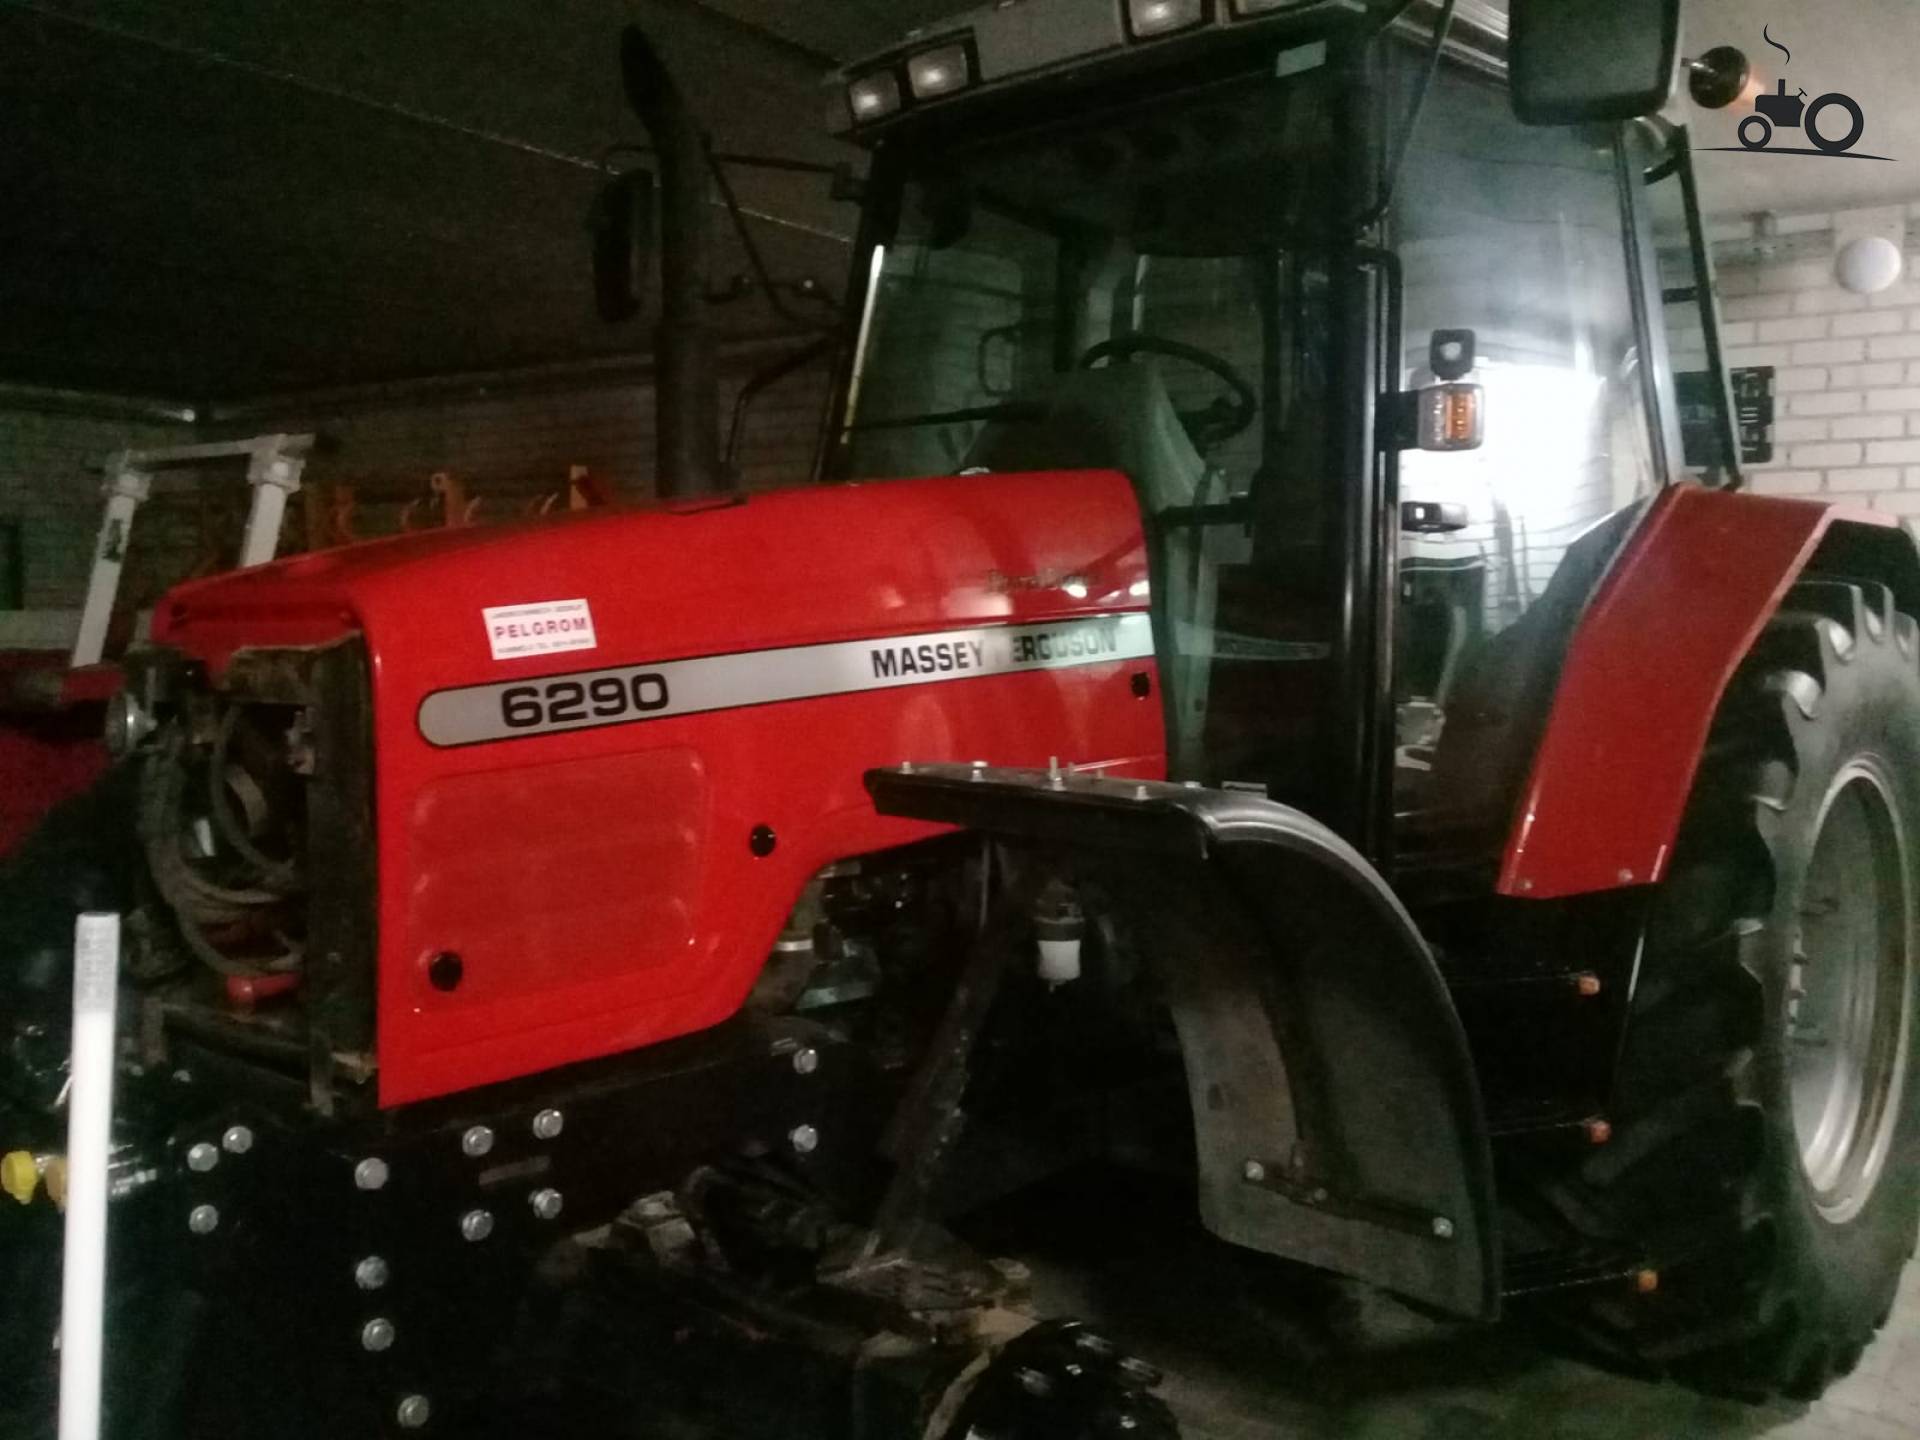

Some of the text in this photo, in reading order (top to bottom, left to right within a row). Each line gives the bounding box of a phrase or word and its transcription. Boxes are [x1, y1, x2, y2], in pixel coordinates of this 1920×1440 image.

[494, 617, 588, 640] PELGROM
[870, 626, 1118, 678] MASSEY ERGUSON
[501, 672, 670, 728] 6290
